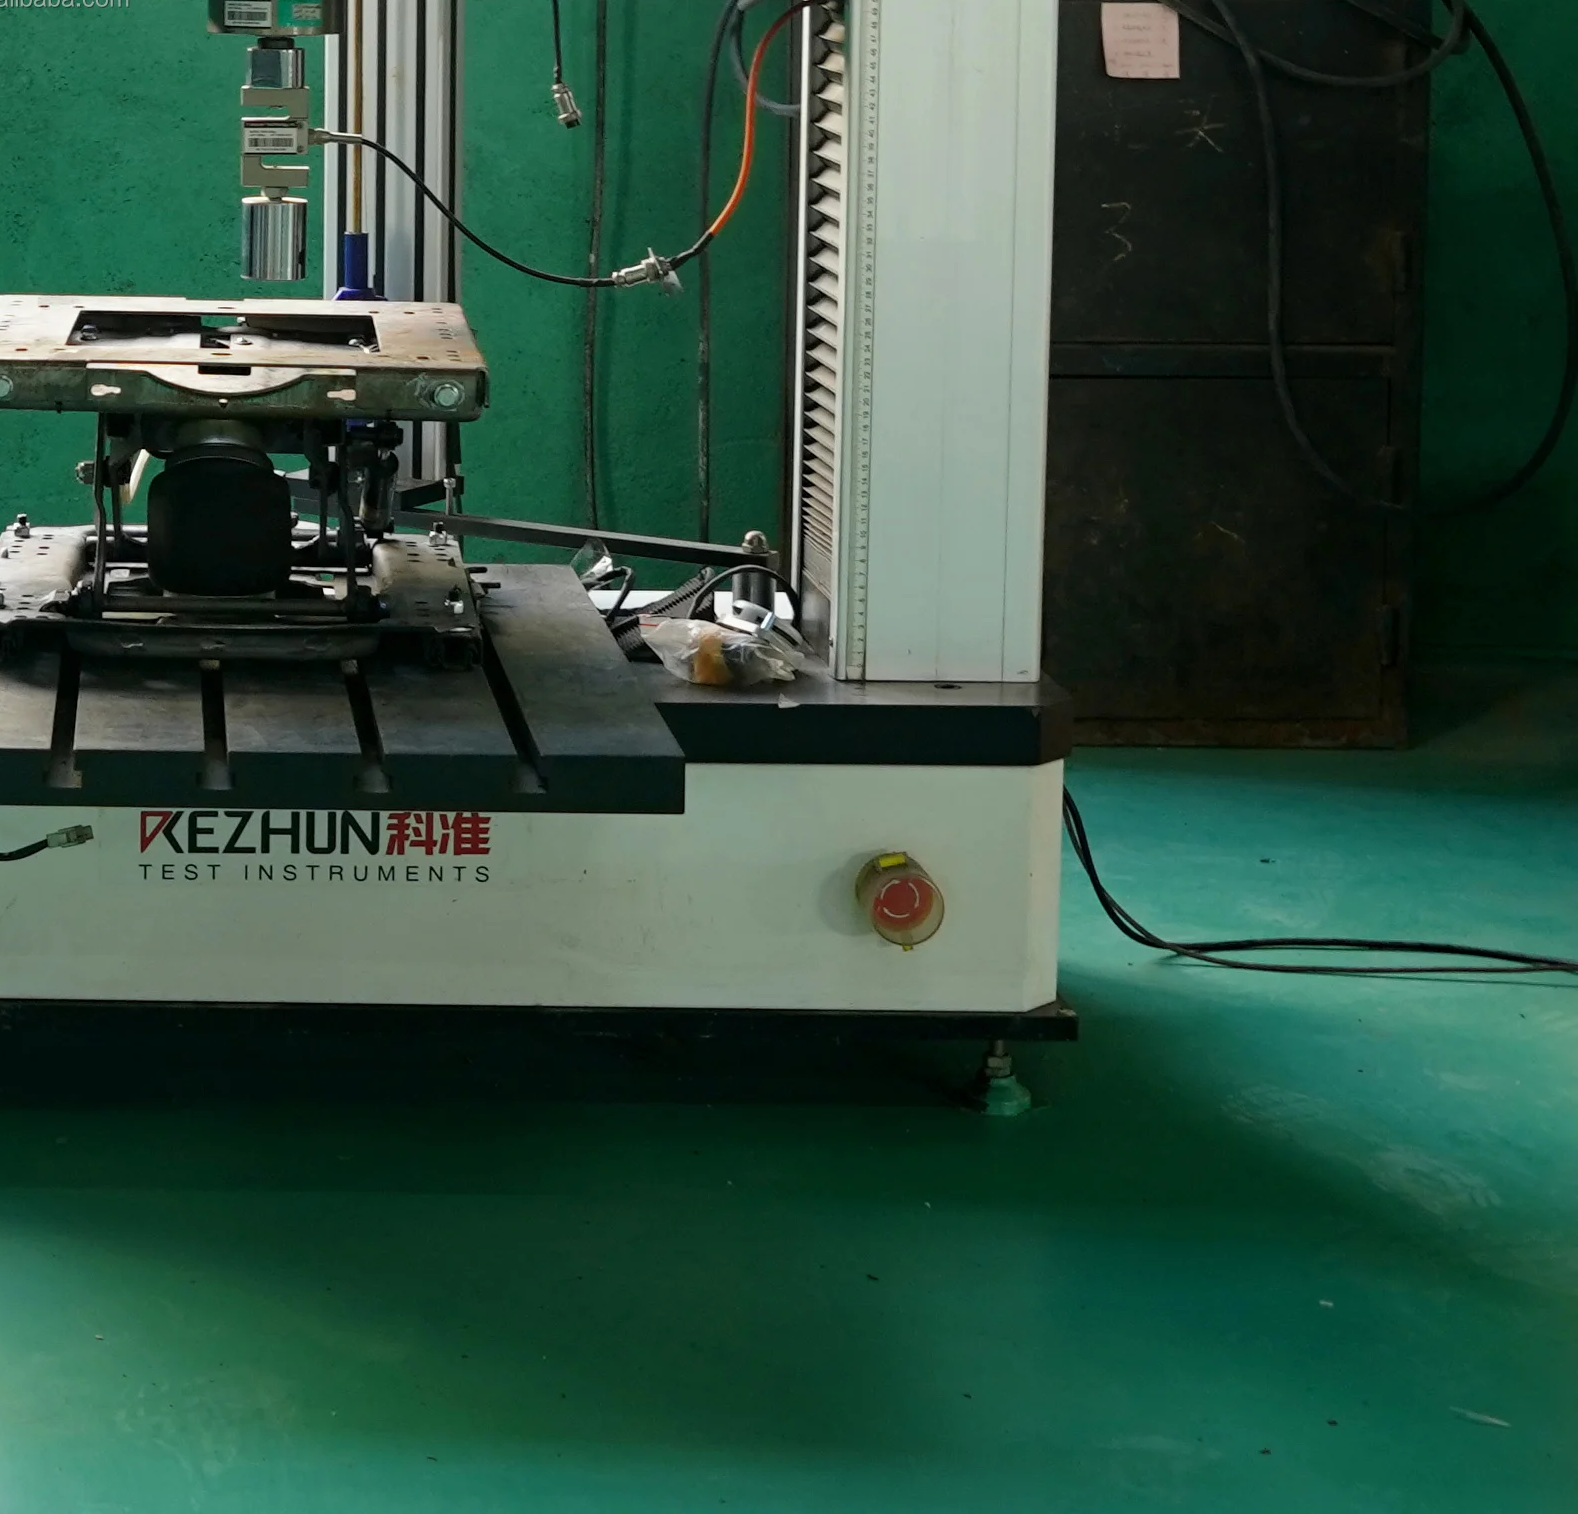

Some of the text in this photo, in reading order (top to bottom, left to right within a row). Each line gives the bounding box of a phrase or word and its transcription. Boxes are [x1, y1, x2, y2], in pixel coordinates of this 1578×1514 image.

[140, 810, 492, 856] KEZHUN 科准
[139, 864, 491, 883] TEST INSTRUMENTS
